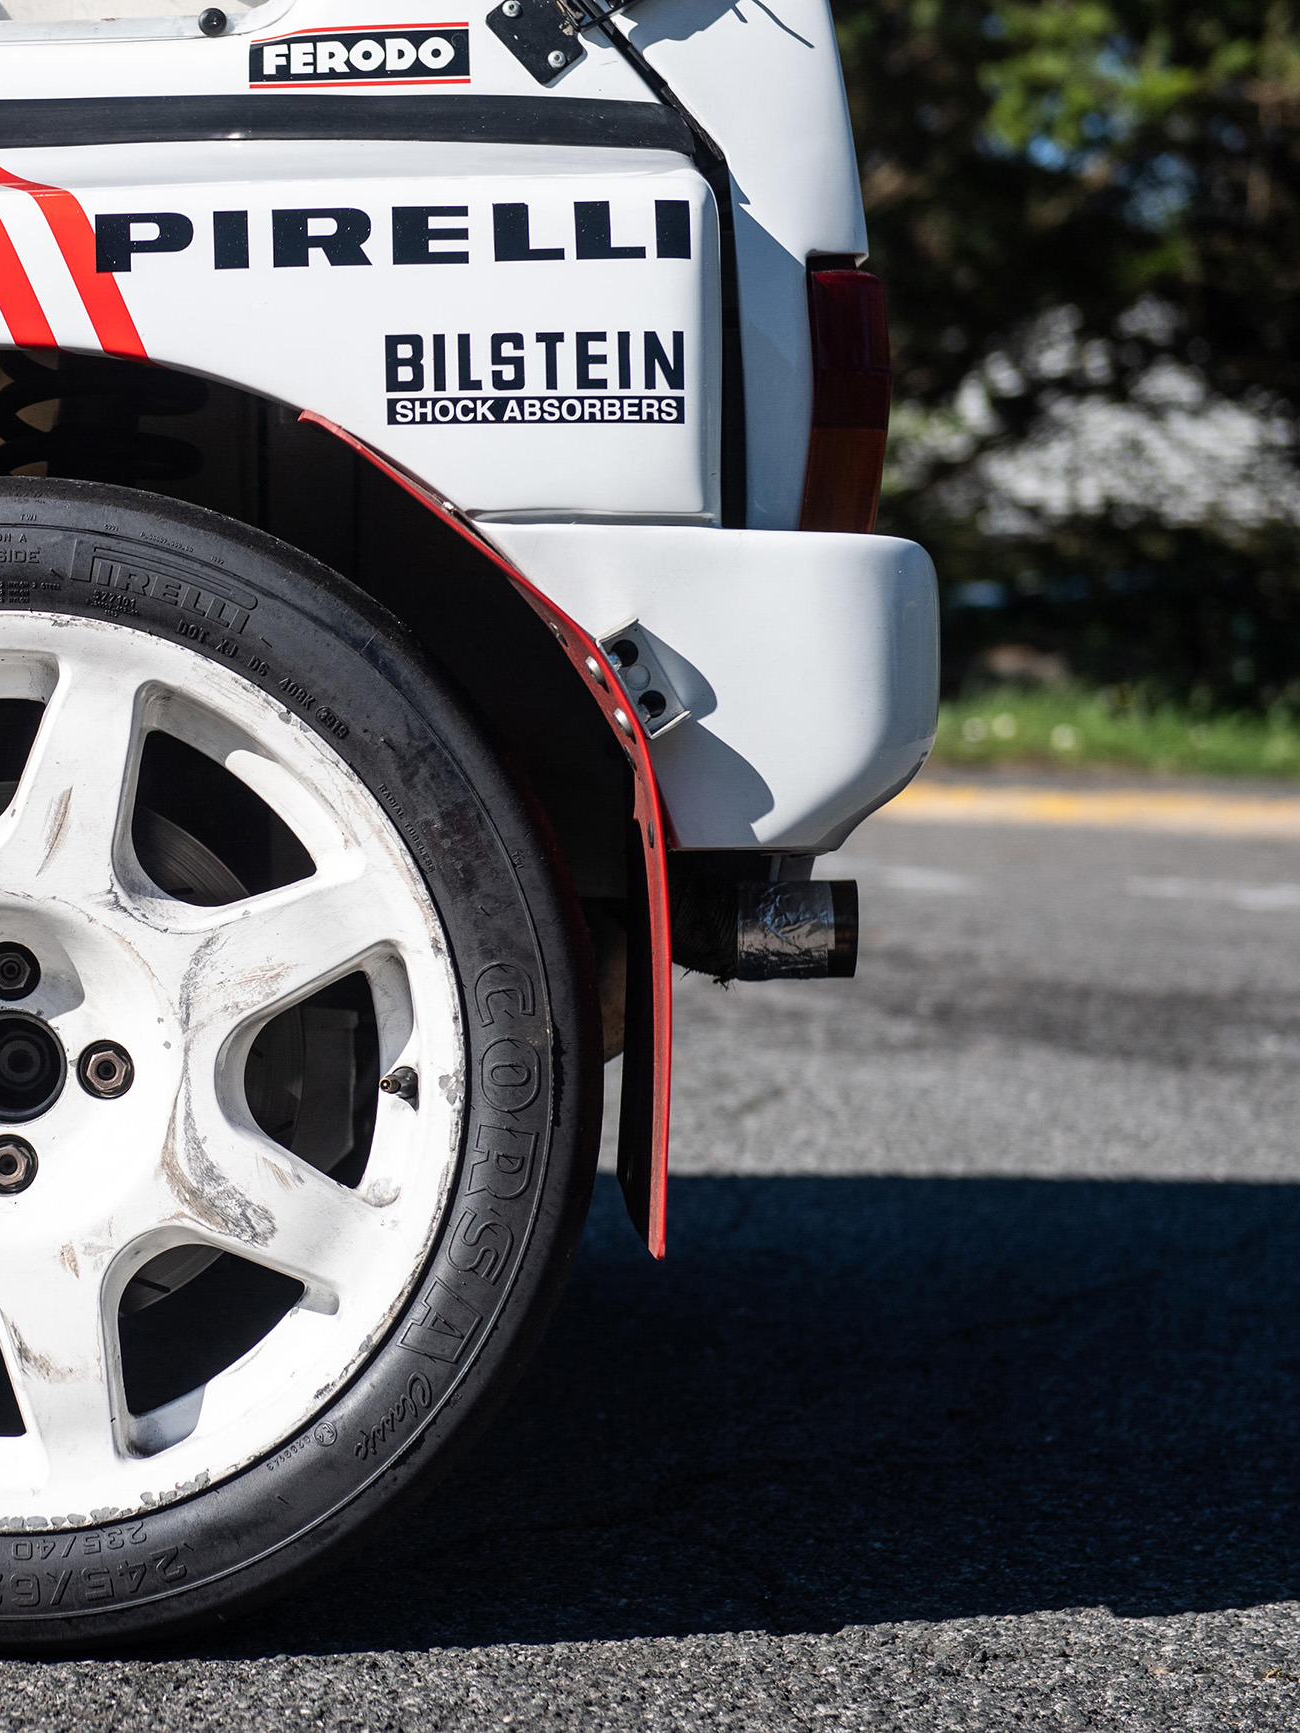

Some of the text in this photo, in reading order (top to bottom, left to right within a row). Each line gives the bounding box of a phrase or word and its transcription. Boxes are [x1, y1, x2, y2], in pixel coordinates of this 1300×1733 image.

[263, 36, 455, 75] FERODO
[95, 199, 691, 273] PIRELLI
[385, 331, 685, 393] BILSTEIN
[394, 398, 678, 423] SHOCK ABSORBERS
[18, 532, 27, 543] A
[69, 539, 259, 634] PIRELLI
[175, 619, 210, 644] DOT
[352, 961, 542, 1462] CORSA Classic
[14, 1520, 148, 1560] 235/40
